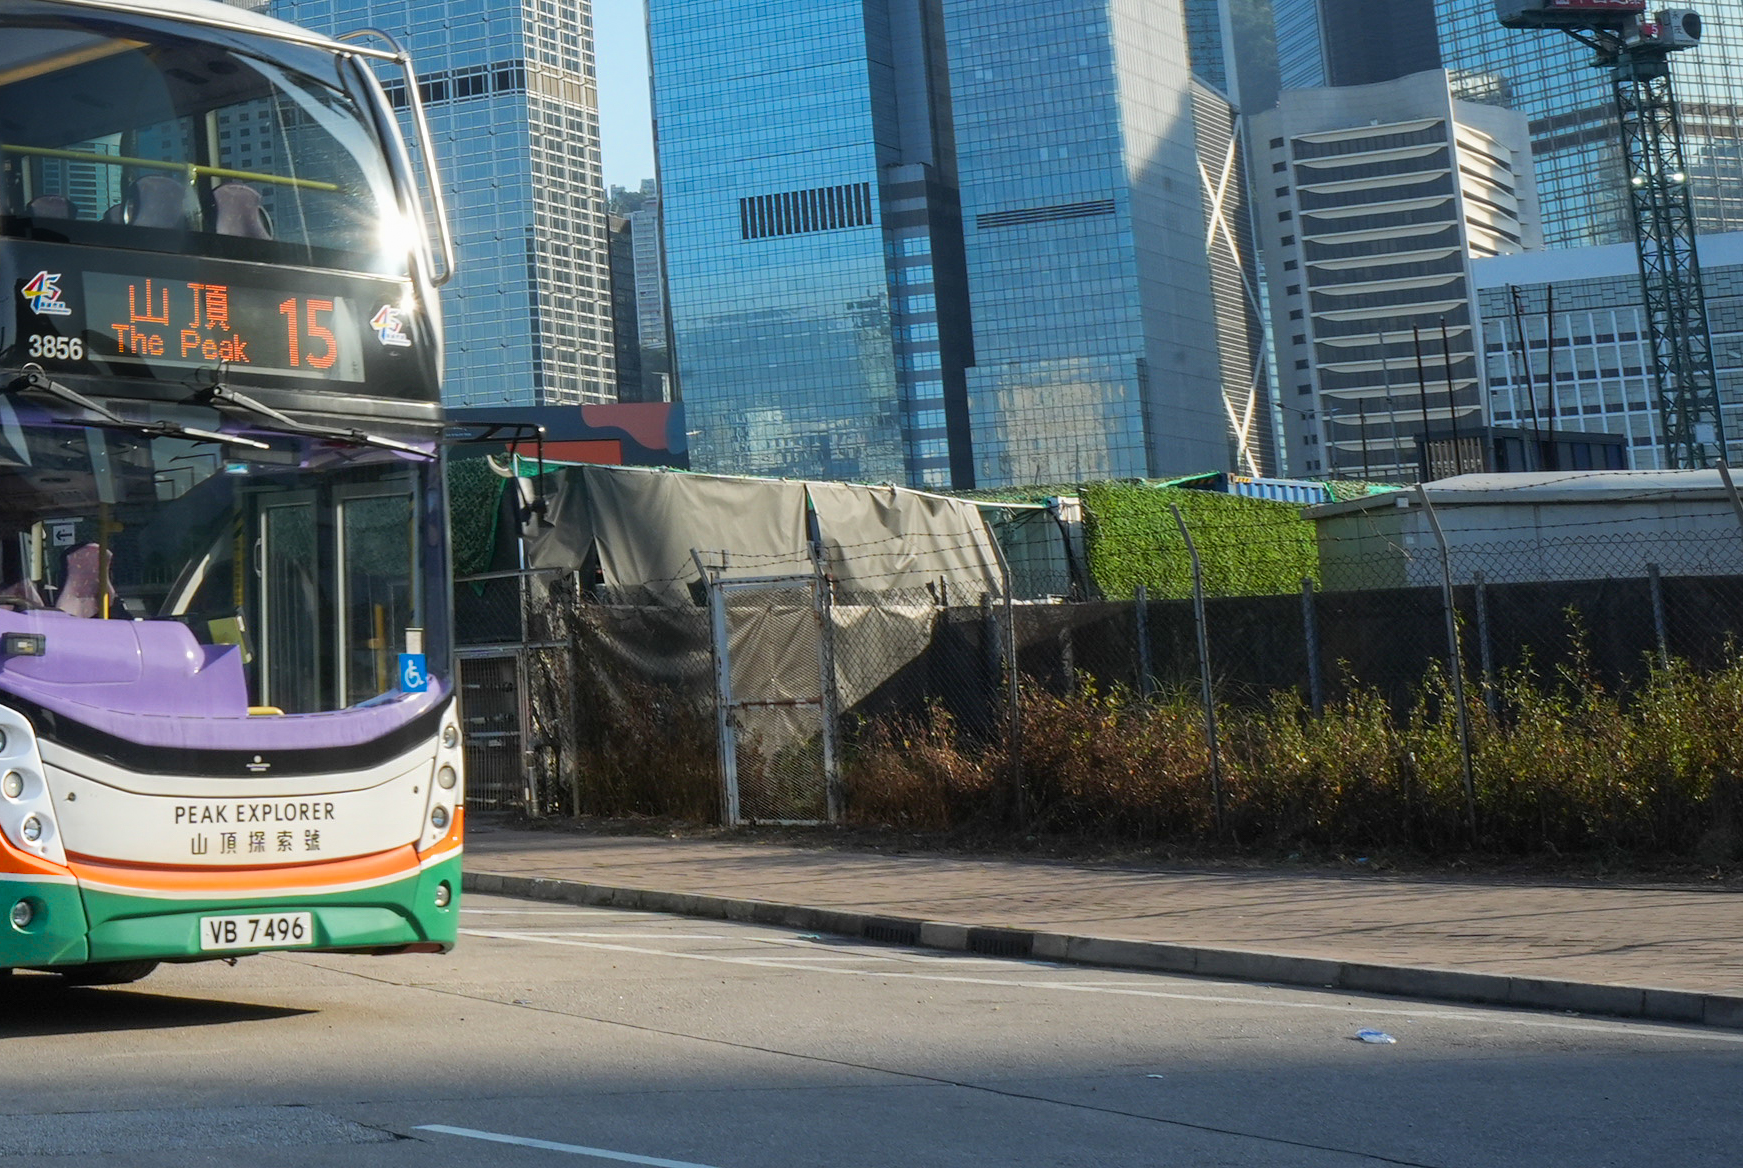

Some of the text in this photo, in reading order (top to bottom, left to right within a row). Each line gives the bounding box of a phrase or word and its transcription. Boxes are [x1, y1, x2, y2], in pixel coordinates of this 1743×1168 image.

[128, 279, 231, 332] 山頂
[111, 323, 251, 363] The Peak
[279, 297, 338, 369] 15
[28, 334, 83, 361] 3856
[175, 802, 335, 825] PEAK EXPLORER
[191, 829, 321, 856] 山頂探索號
[210, 917, 304, 944] VB 7496
